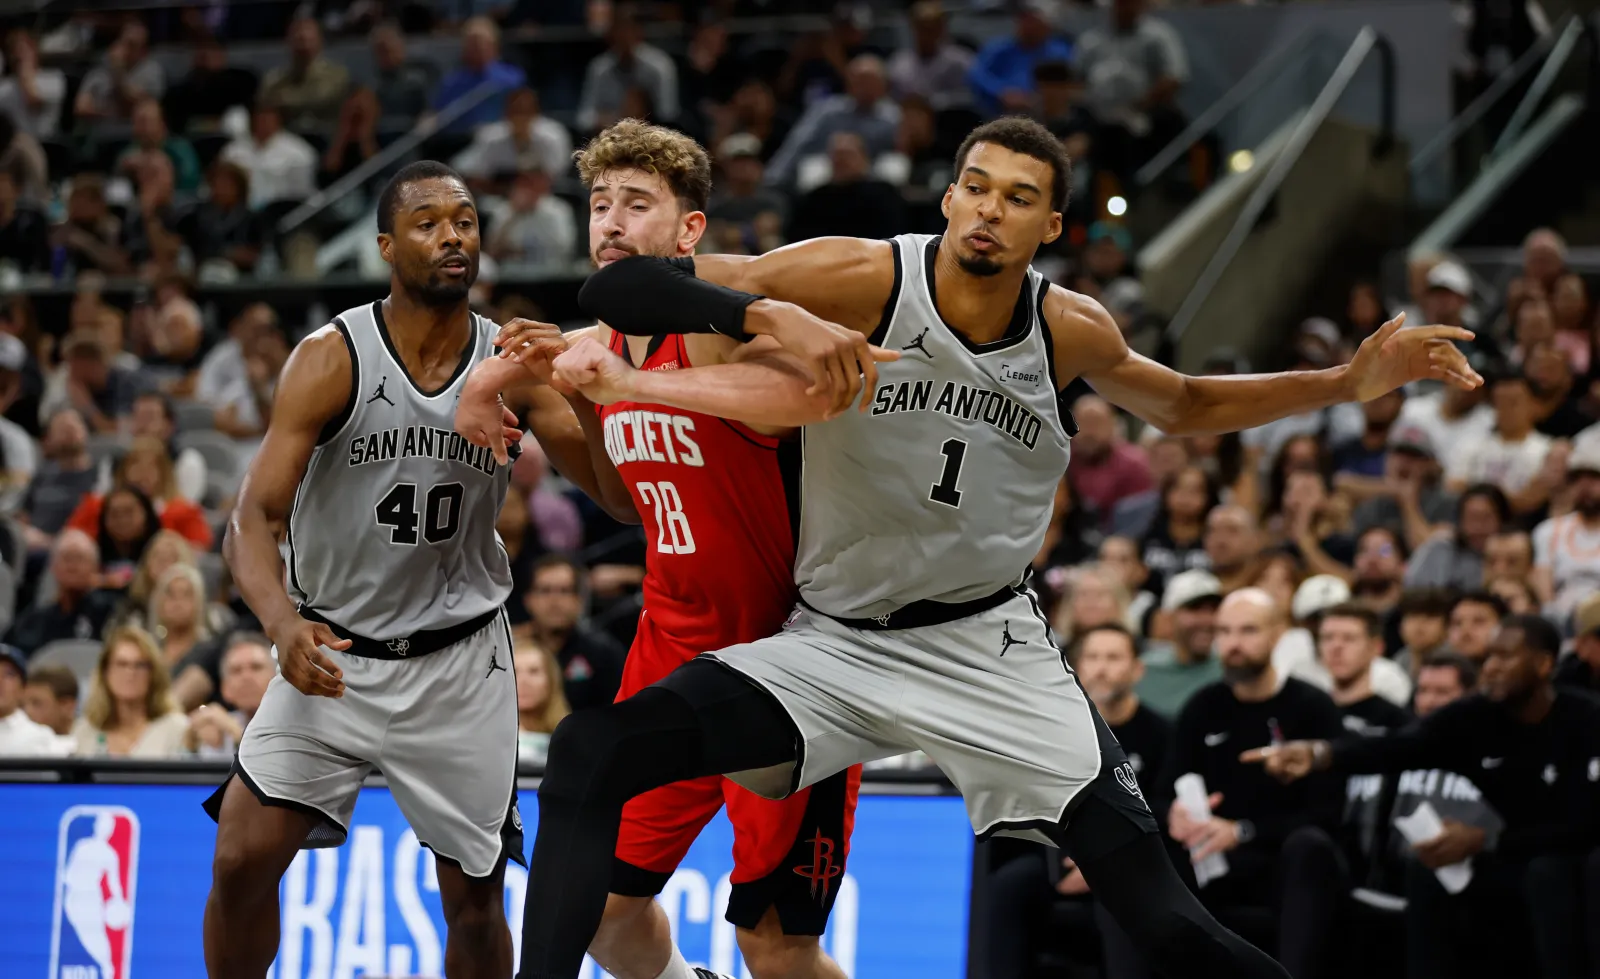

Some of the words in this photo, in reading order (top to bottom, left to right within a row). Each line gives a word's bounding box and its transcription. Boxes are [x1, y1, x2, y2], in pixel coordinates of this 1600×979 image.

[1006, 370, 1039, 383] LEDGER
[603, 410, 705, 468] ROCKETS
[871, 379, 935, 417] SAN
[932, 380, 1042, 452] ANTONIO
[349, 427, 400, 467] SAN
[401, 424, 497, 477] ANTONIO
[928, 436, 968, 509] 1
[374, 481, 465, 546] 40
[636, 481, 697, 555] 28
